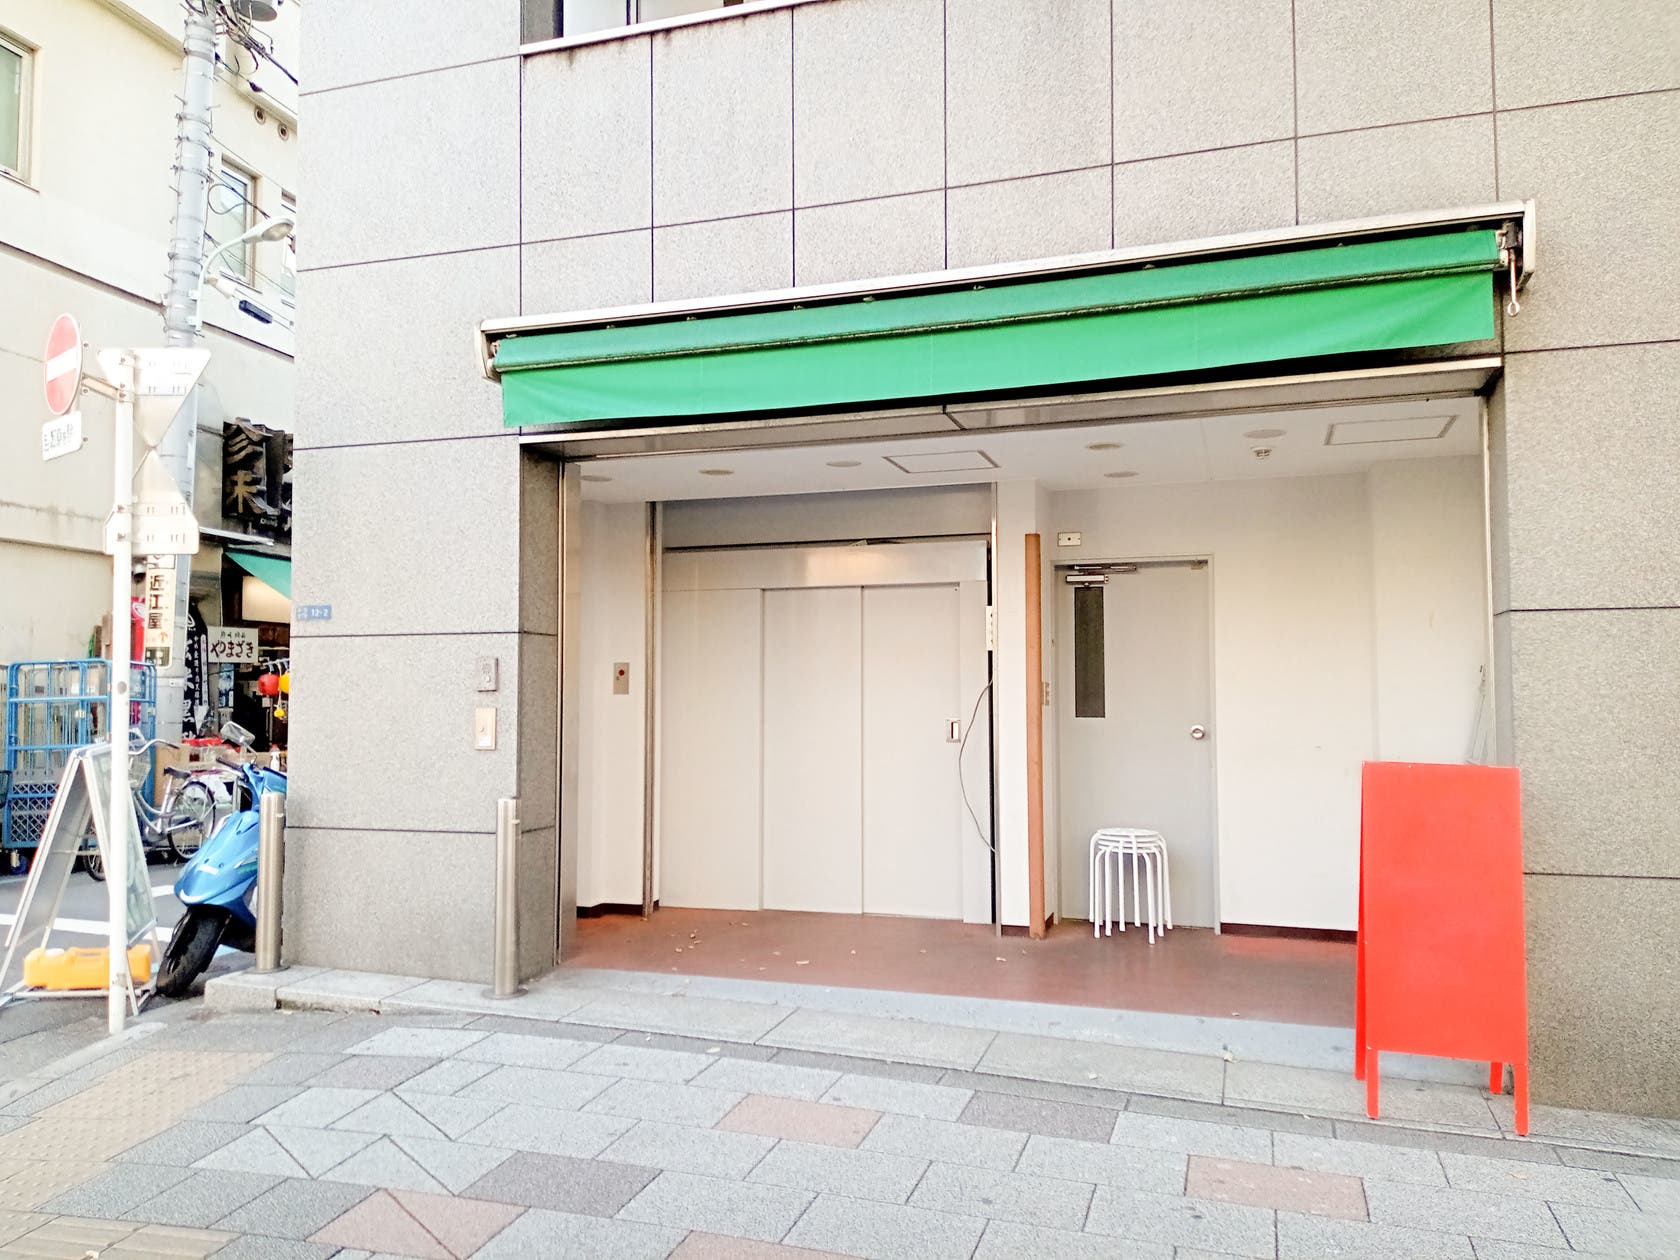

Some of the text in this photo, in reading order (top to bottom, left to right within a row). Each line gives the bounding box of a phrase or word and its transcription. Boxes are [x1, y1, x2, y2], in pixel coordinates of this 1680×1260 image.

[148, 575, 165, 629] 近江屋
[210, 640, 254, 659] やまざき
